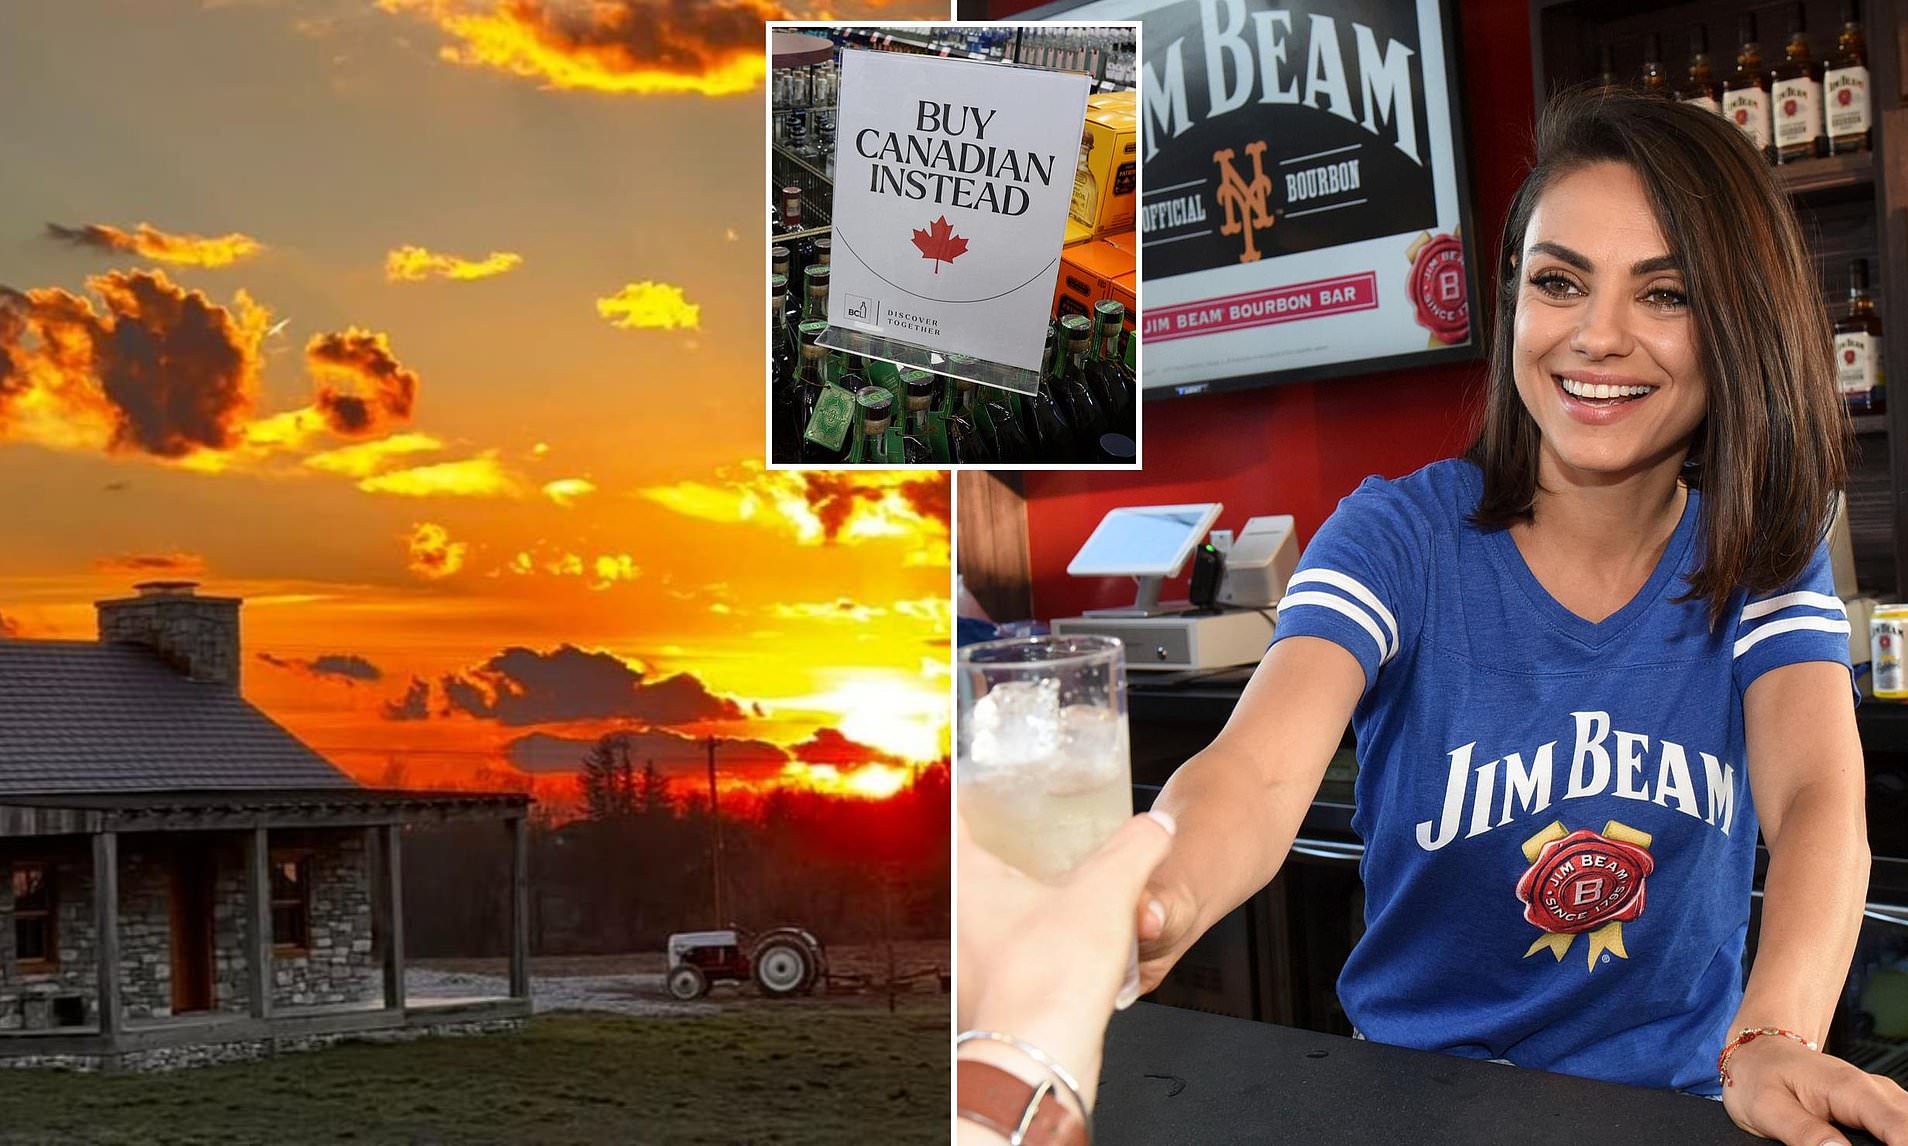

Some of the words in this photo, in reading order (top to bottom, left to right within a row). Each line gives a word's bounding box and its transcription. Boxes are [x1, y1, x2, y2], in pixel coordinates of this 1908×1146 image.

[1201, 0, 1423, 167] BEAM
[916, 100, 997, 139] BUY
[856, 128, 1056, 186] CANADIAN
[870, 163, 1030, 216] INSTEAD
[1142, 194, 1207, 233] OFFICIAL
[1286, 159, 1361, 203] BOURBON
[887, 309, 938, 327] DISCOVER
[887, 318, 941, 336] TOGETHER
[1143, 316, 1170, 334] JIM
[1176, 308, 1222, 329] BEAM
[1229, 295, 1312, 321] BOURBON
[1319, 286, 1356, 306] BAR
[1415, 740, 1558, 852] JIM
[1562, 710, 1735, 837] BEAM
[1550, 861, 1575, 887] JIM
[1581, 854, 1628, 882] BEAM
[1573, 878, 1603, 906] B
[1545, 897, 1588, 921] SINCE
[1595, 886, 1625, 912] 1795
